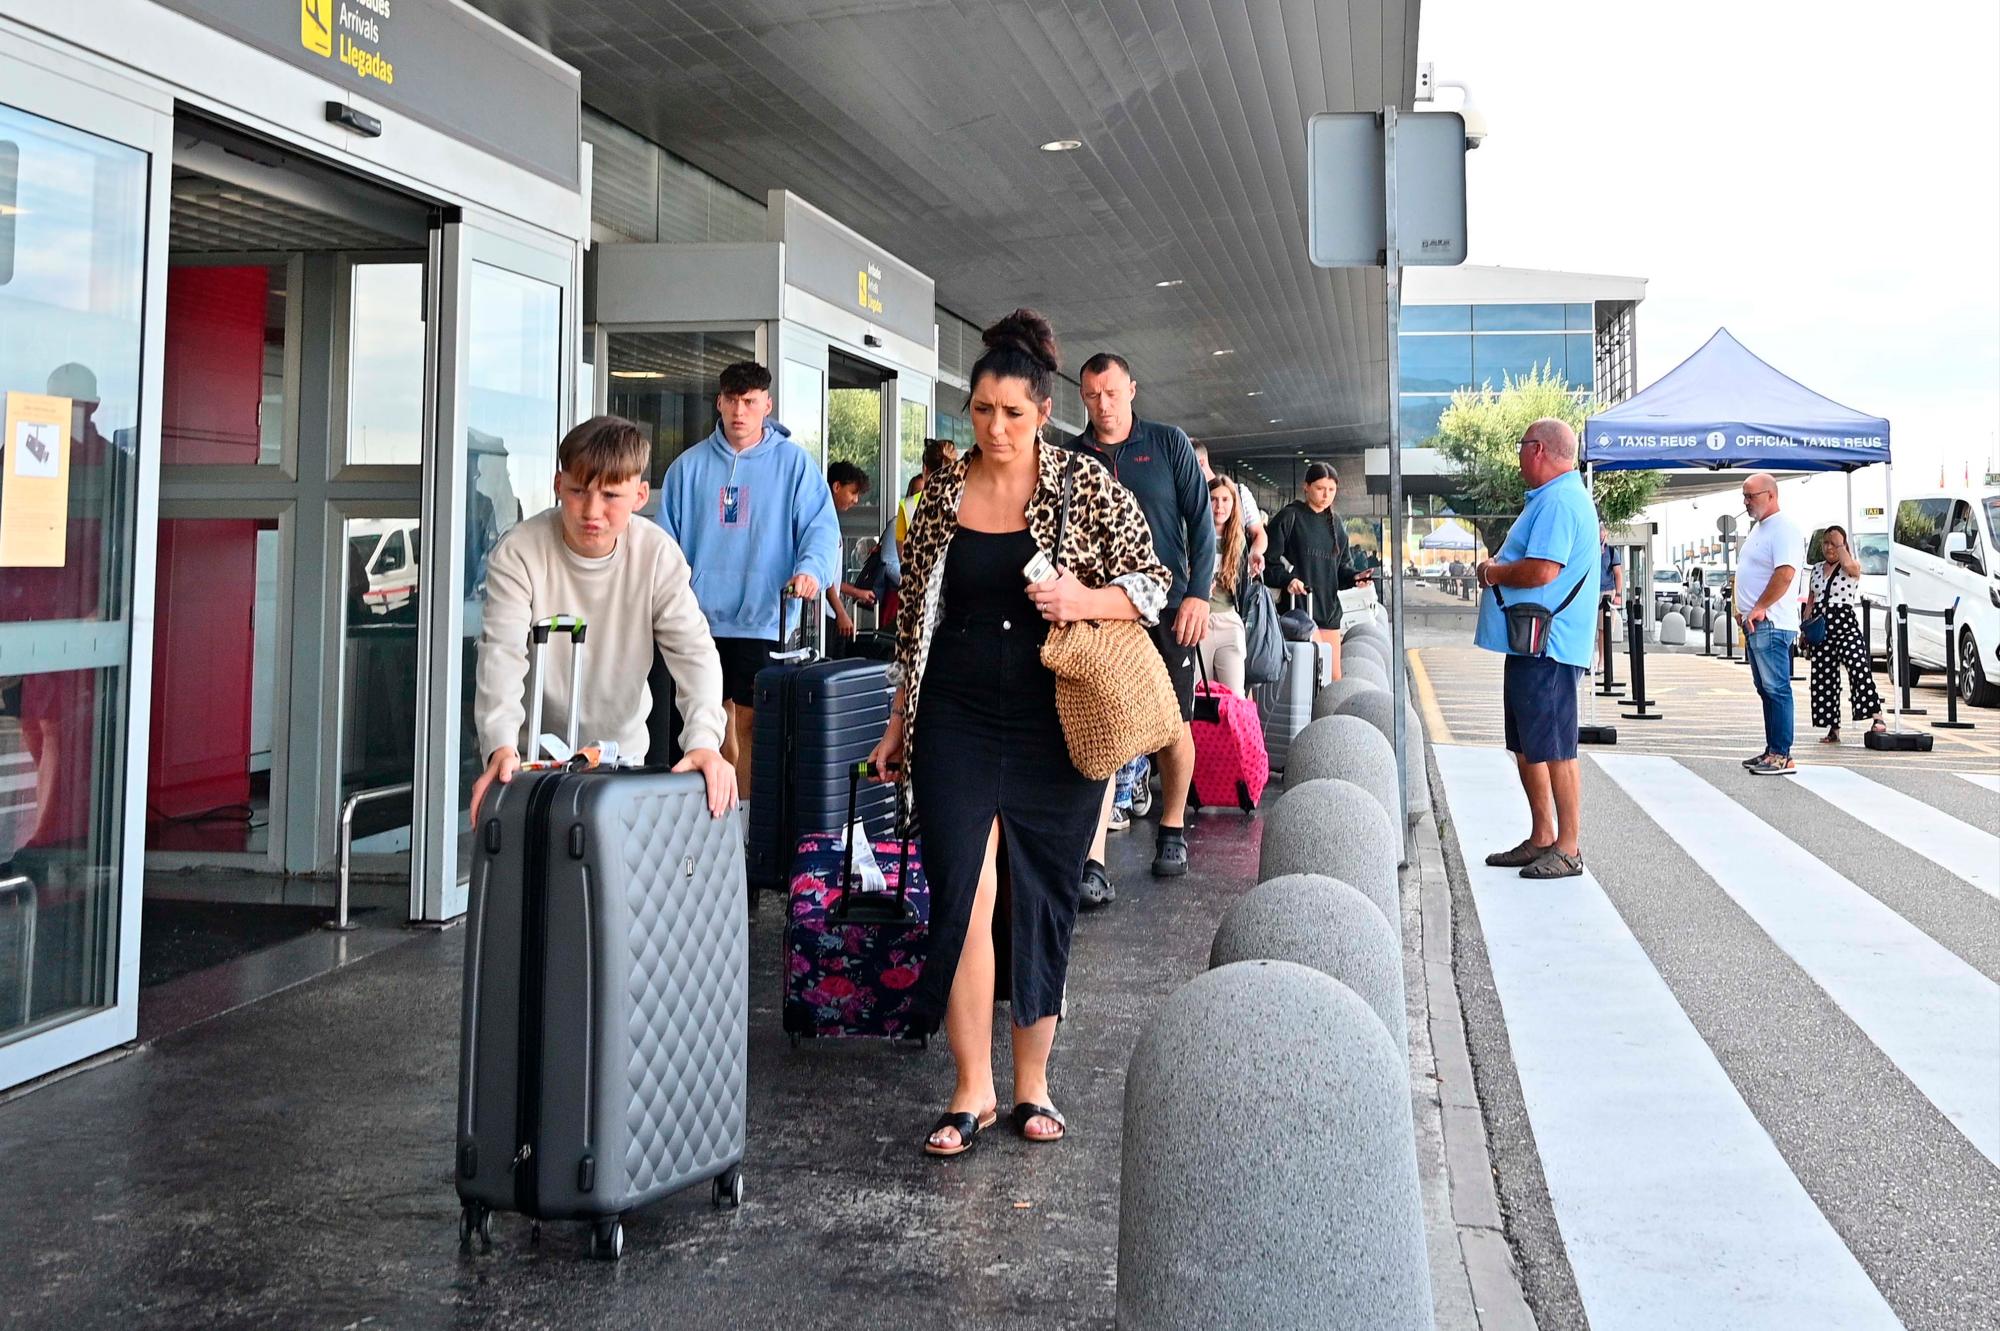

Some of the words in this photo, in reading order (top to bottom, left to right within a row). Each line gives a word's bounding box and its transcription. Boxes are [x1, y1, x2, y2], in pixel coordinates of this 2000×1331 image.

[340, 2, 379, 44] Arrivals
[340, 34, 393, 85] Llegadas
[1618, 435, 1657, 447] TAXIS
[1659, 435, 1697, 447] REUS
[1735, 435, 1798, 447] OFFICIAL
[1802, 437, 1841, 448] TAXIS
[1844, 437, 1882, 448] REUS
